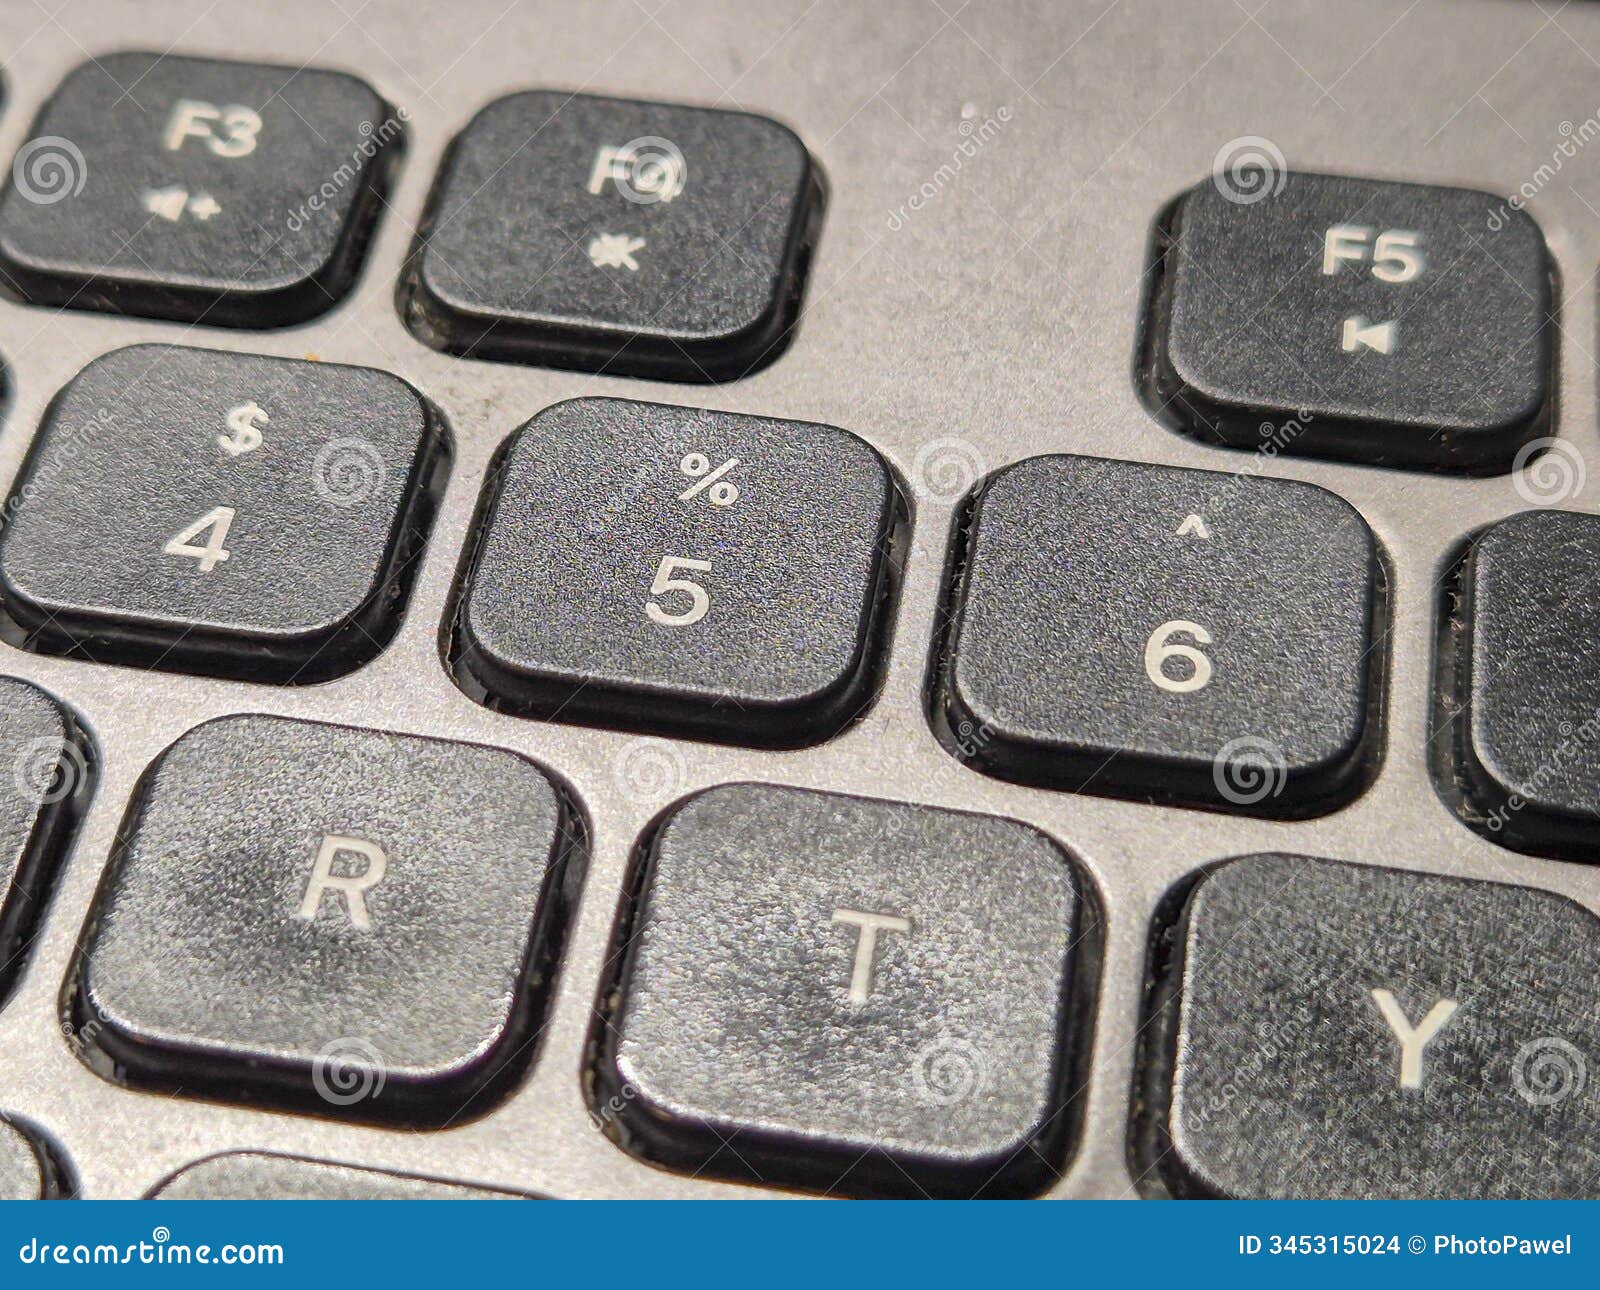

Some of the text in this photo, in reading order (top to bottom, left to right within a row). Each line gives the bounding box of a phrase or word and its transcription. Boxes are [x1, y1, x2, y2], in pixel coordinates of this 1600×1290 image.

[165, 99, 263, 158] F3
[588, 143, 684, 203] F4
[1323, 225, 1423, 283] F5
[217, 402, 270, 457] $
[677, 452, 741, 506] %
[164, 505, 237, 573] 4
[644, 555, 713, 627] 5
[1144, 620, 1214, 693] 6
[297, 832, 387, 930] R
[830, 908, 912, 1003] T
[1371, 988, 1458, 1089] Y
